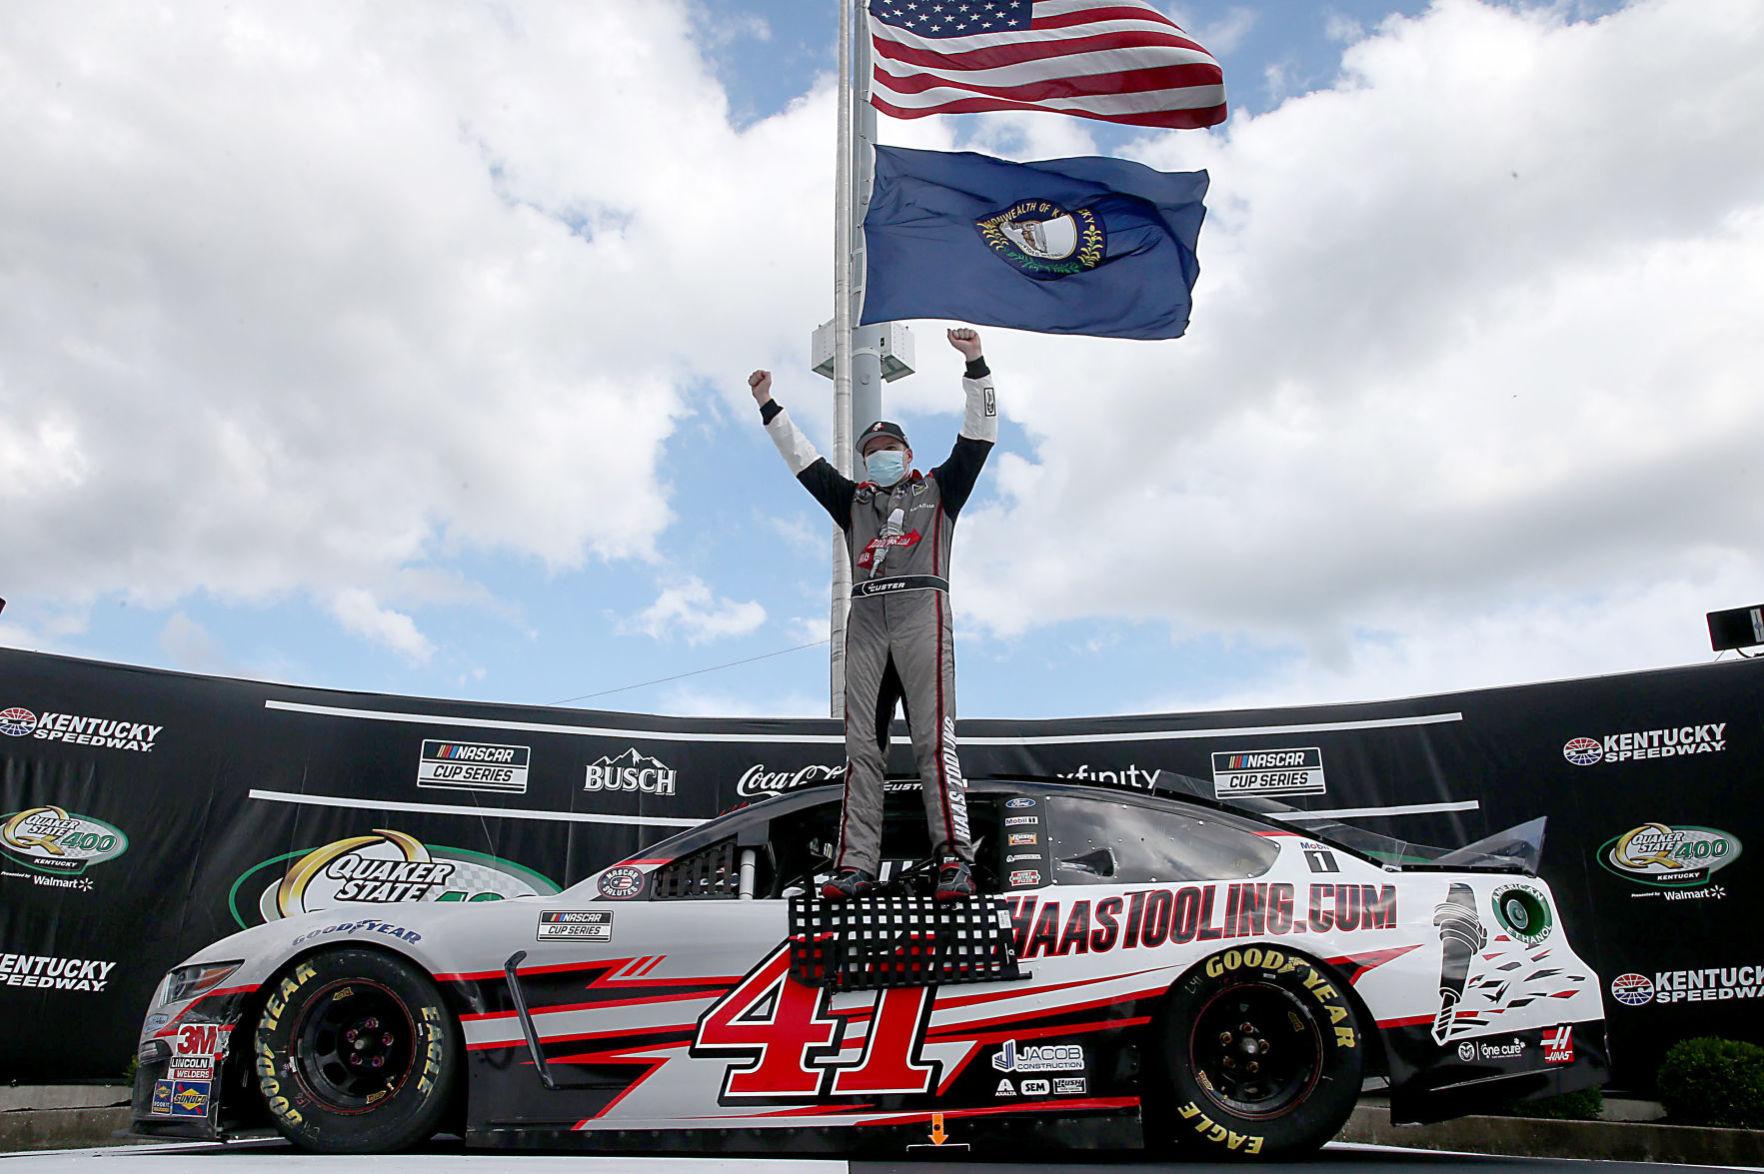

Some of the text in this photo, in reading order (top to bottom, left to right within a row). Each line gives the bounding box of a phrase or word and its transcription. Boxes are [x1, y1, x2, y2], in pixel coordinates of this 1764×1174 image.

[36, 711, 164, 742] KENTUCKY
[33, 728, 156, 752] SPEEDWAY
[1603, 722, 1727, 752] KENTUCKY
[455, 745, 515, 763] NASCAR
[1247, 752, 1305, 768] NASCAR
[1604, 740, 1726, 763] SPEEDWAY
[433, 764, 513, 783] CUP SERIES
[583, 764, 677, 796] BUSCH
[1057, 763, 1162, 790] finity
[1229, 771, 1309, 788] CUP SERIES
[25, 814, 80, 830] QUAKER
[948, 790, 971, 840] HAAS
[28, 825, 69, 836] STATE
[1631, 832, 1685, 846] QUAKER
[61, 831, 118, 852] 400
[1638, 841, 1676, 853] STATE
[1674, 839, 1730, 859] 400
[33, 858, 78, 868] KENTUCKY
[327, 853, 455, 885] QUAKER
[33, 875, 78, 889] Walmart
[606, 868, 639, 879] NASCAR
[1657, 872, 1700, 881] KENTUCKY
[334, 880, 432, 902] STATE
[602, 884, 639, 896] SALUTES
[1492, 883, 1545, 901] AMERICAN
[1663, 888, 1710, 901] Walmart
[562, 913, 602, 923] NASCAR
[292, 919, 422, 946] GOODYEAR
[548, 925, 602, 935] CUP SERIES
[1506, 924, 1552, 944] ETHANOL
[1655, 965, 1764, 992] KENTUCK
[1205, 947, 1357, 1049] GOODYEAR
[689, 932, 942, 1104] 41
[177, 1025, 218, 1055] 3M
[255, 960, 318, 1127] GOODYEAR
[1017, 1047, 1081, 1061] JACOB
[1482, 1044, 1521, 1056] one cure
[170, 1057, 209, 1069] LINCOLN
[1017, 1061, 1083, 1070] CONSTRUCTION
[176, 1070, 210, 1078] WELDERS
[1025, 1082, 1046, 1093] SEM
[173, 1094, 208, 1104] SUNOCO
[1177, 1101, 1265, 1154] EAGLE
